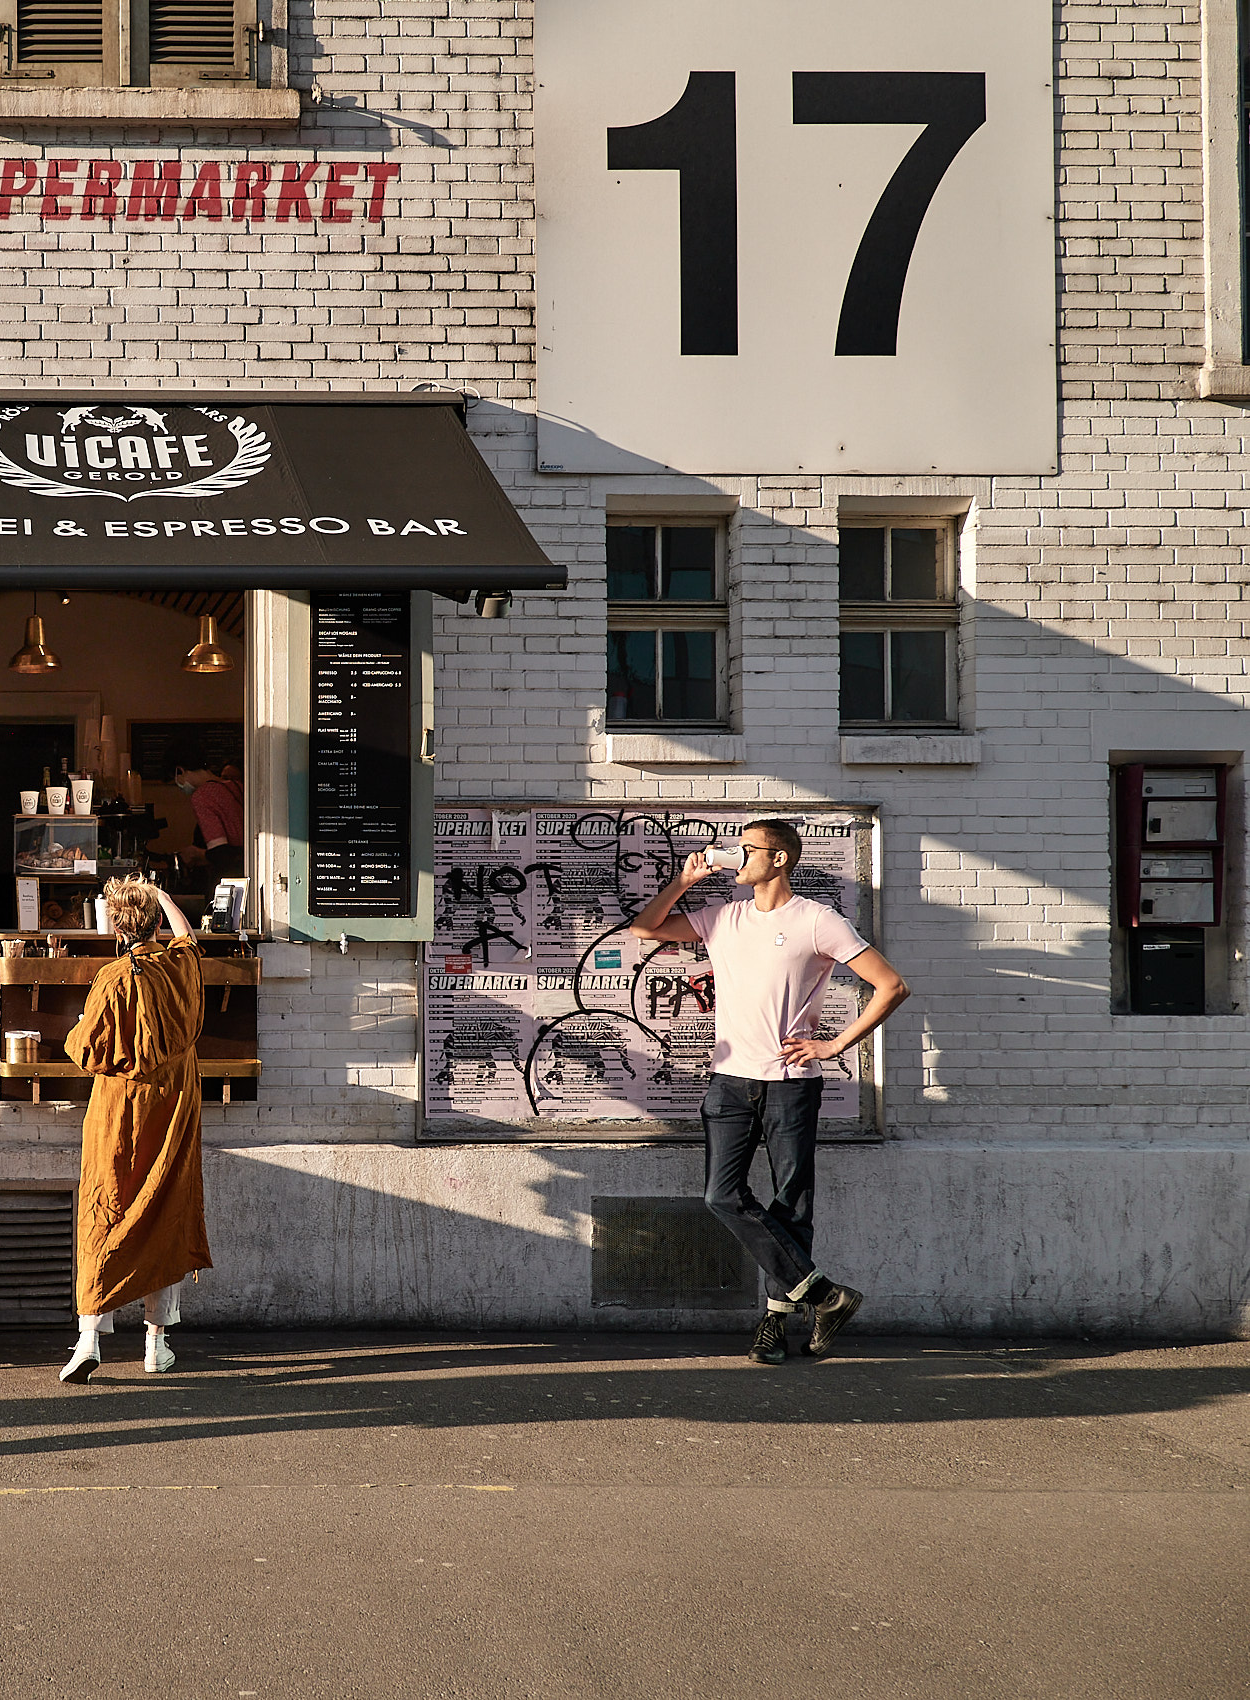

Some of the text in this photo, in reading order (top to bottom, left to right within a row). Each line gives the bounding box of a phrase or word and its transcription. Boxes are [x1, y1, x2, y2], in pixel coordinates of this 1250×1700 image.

[607, 71, 986, 356] 17
[63, 471, 184, 481] GEROLD
[53, 519, 88, 537] &
[104, 516, 351, 537] ESPRESSO
[366, 517, 468, 536] BAR
[434, 821, 526, 836] UPERMAKET
[537, 821, 634, 835] SUPEMARKT
[446, 864, 563, 901] NOT
[430, 976, 527, 990] SUPERMARKET
[538, 975, 635, 990] SUPEMARKET
